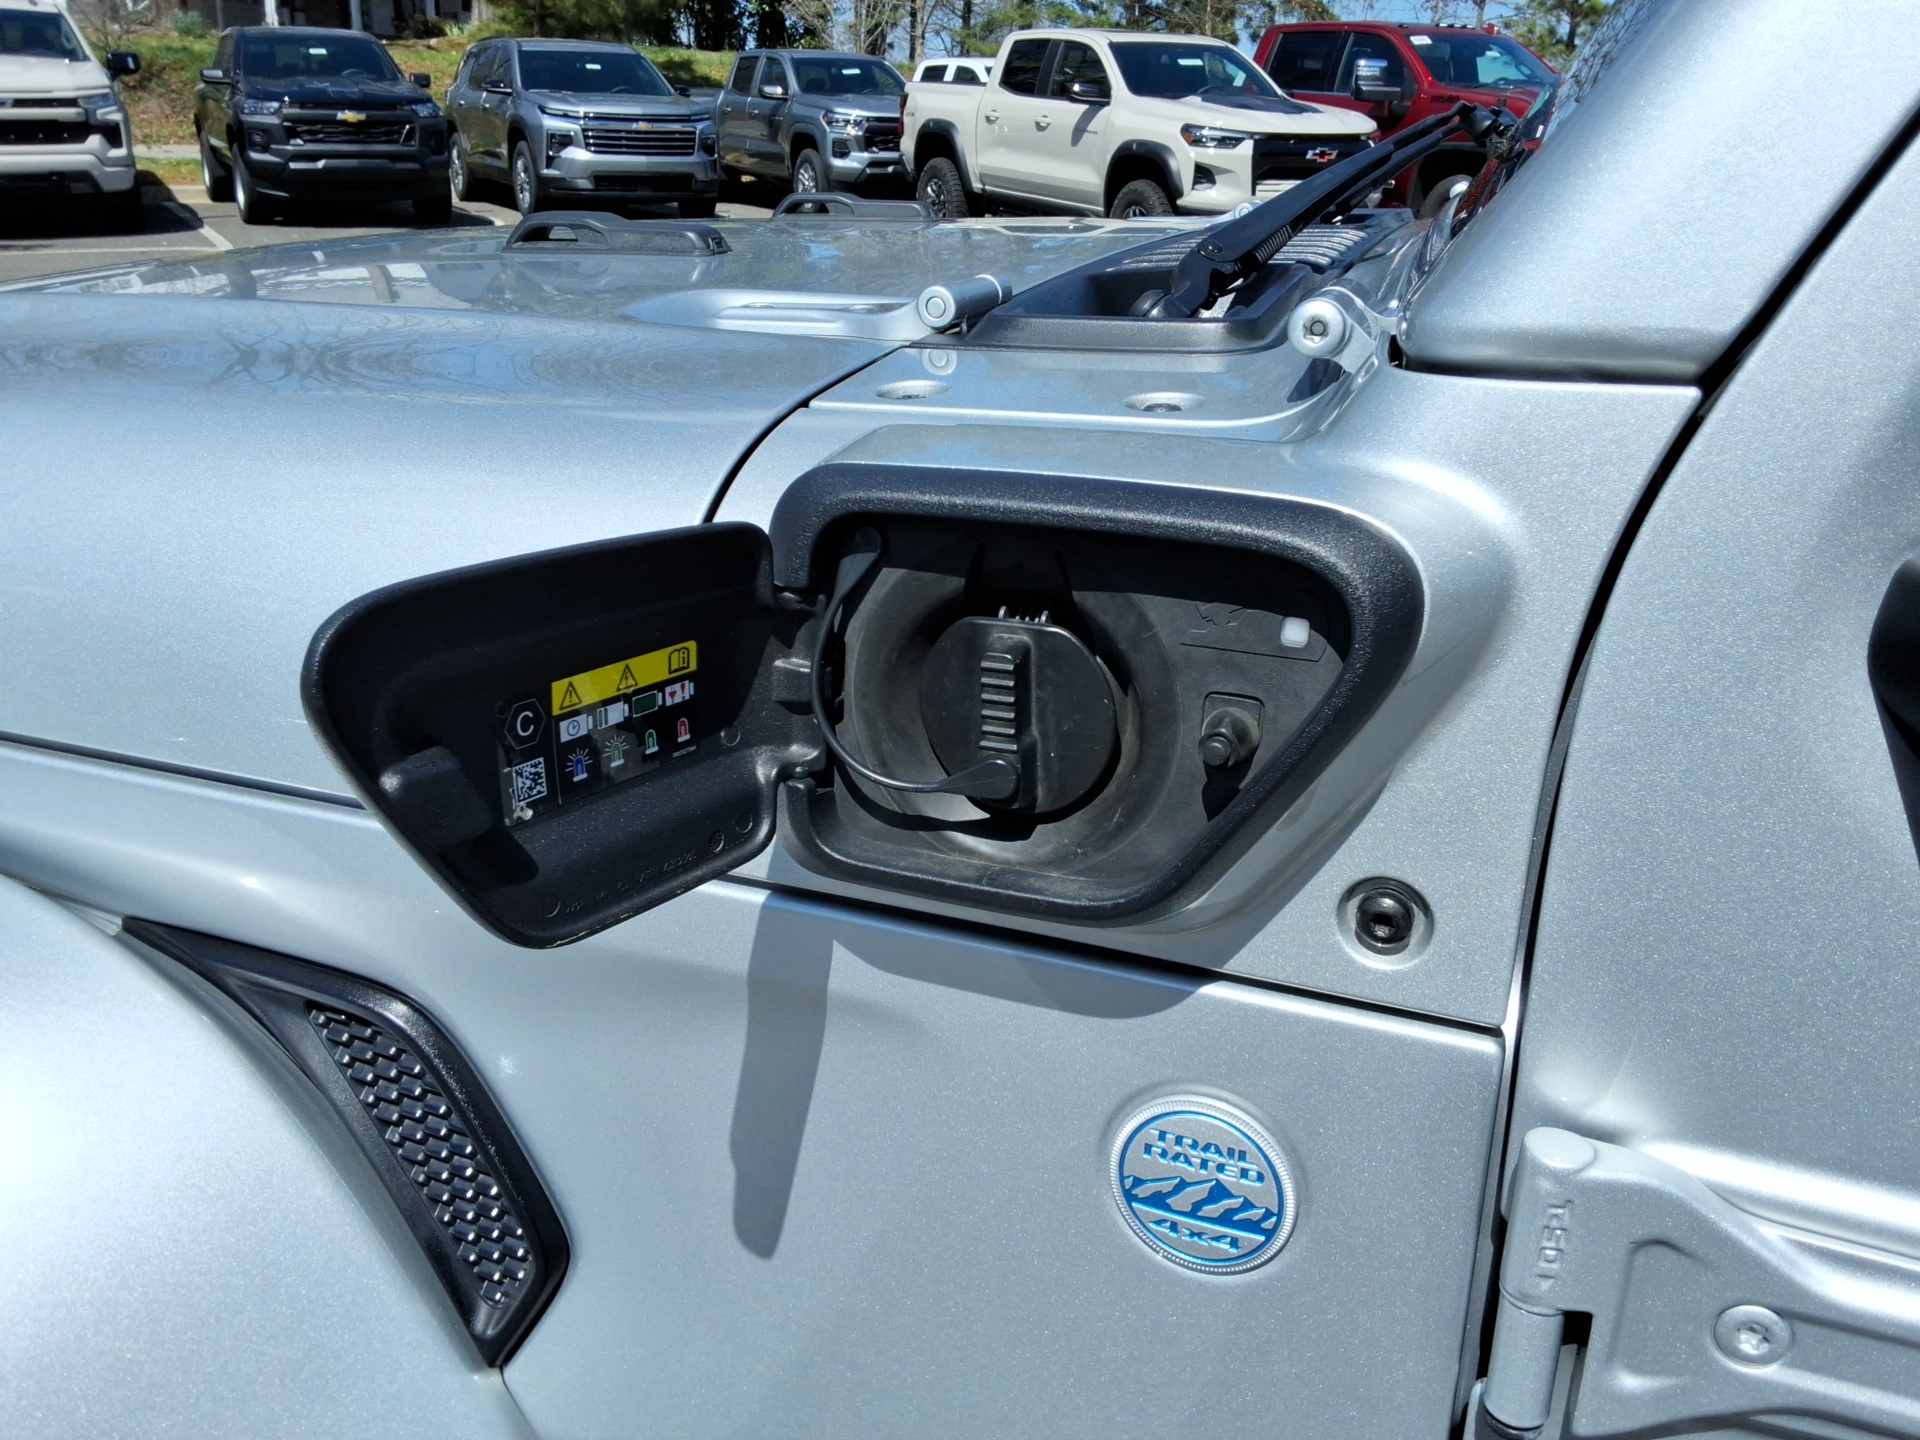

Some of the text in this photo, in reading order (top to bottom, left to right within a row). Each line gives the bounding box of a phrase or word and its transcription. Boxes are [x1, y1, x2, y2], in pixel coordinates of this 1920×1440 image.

[516, 710, 535, 737] C
[1143, 1142, 1266, 1187] RATED
[1150, 1127, 1259, 1170] TRAIL
